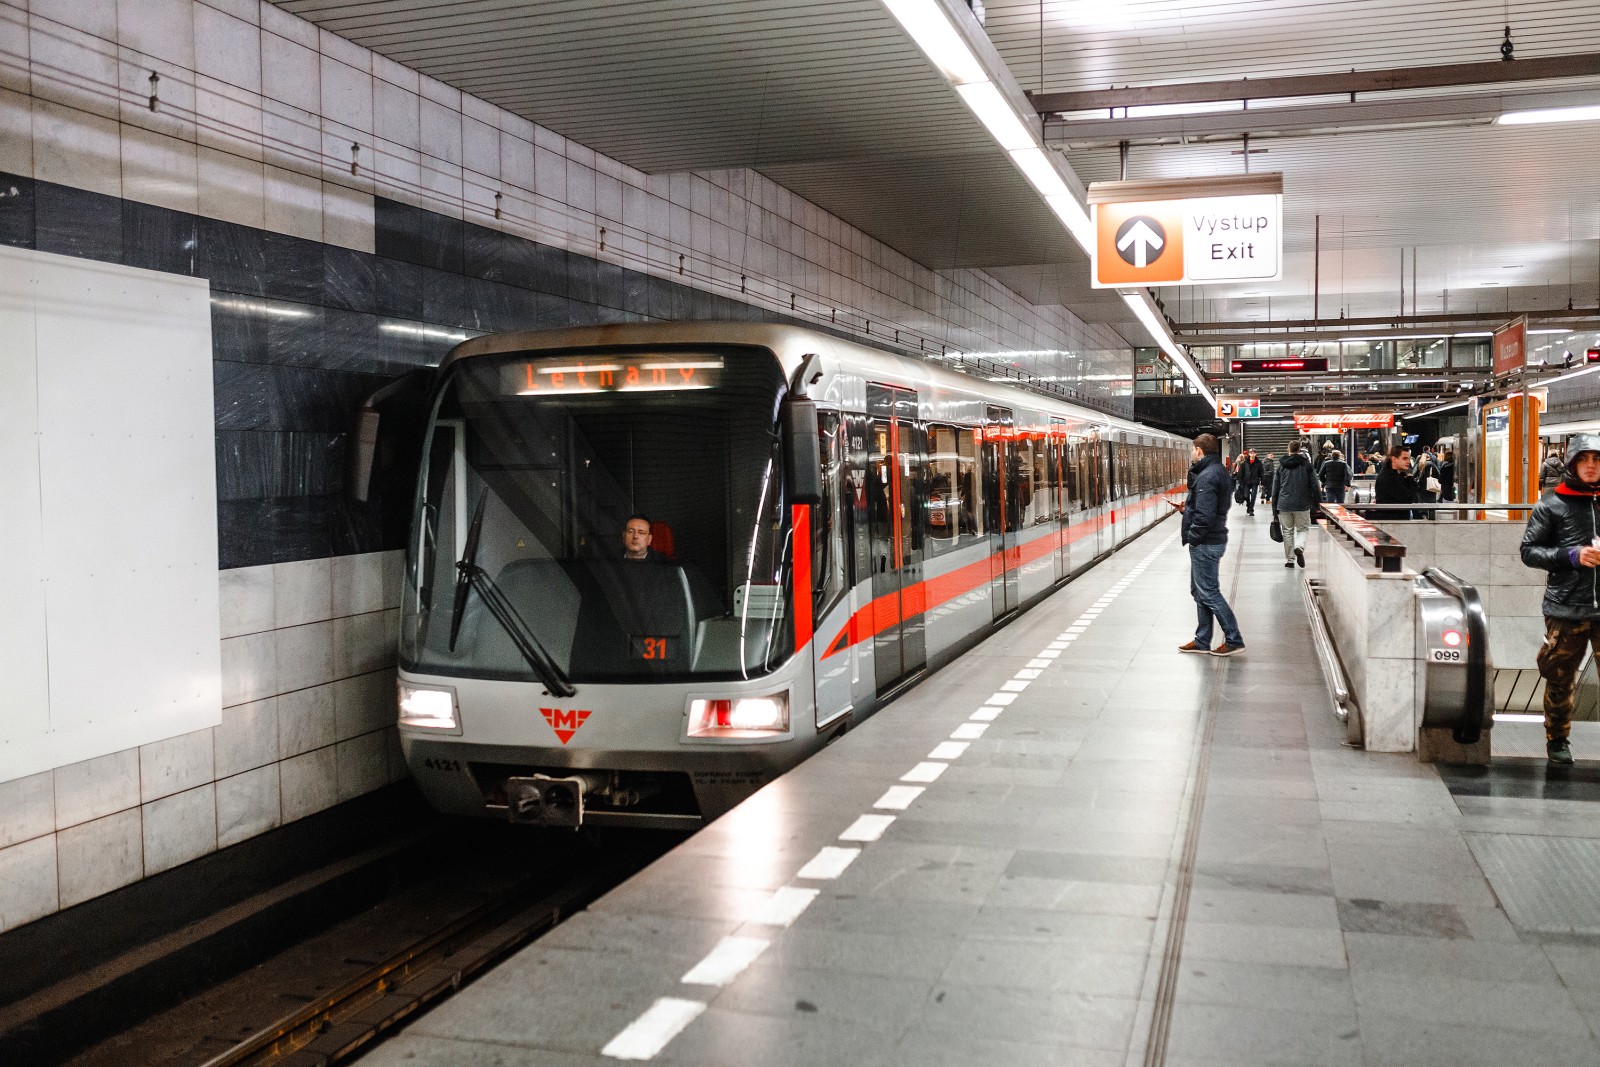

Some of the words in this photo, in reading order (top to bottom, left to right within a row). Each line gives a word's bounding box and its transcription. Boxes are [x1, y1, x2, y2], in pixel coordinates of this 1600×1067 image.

[1211, 242, 1254, 259] Exit
[1244, 408, 1253, 417] A
[851, 436, 864, 450] 4121
[642, 637, 667, 660] 31
[1434, 650, 1460, 661] 099
[425, 758, 462, 772] 4121
